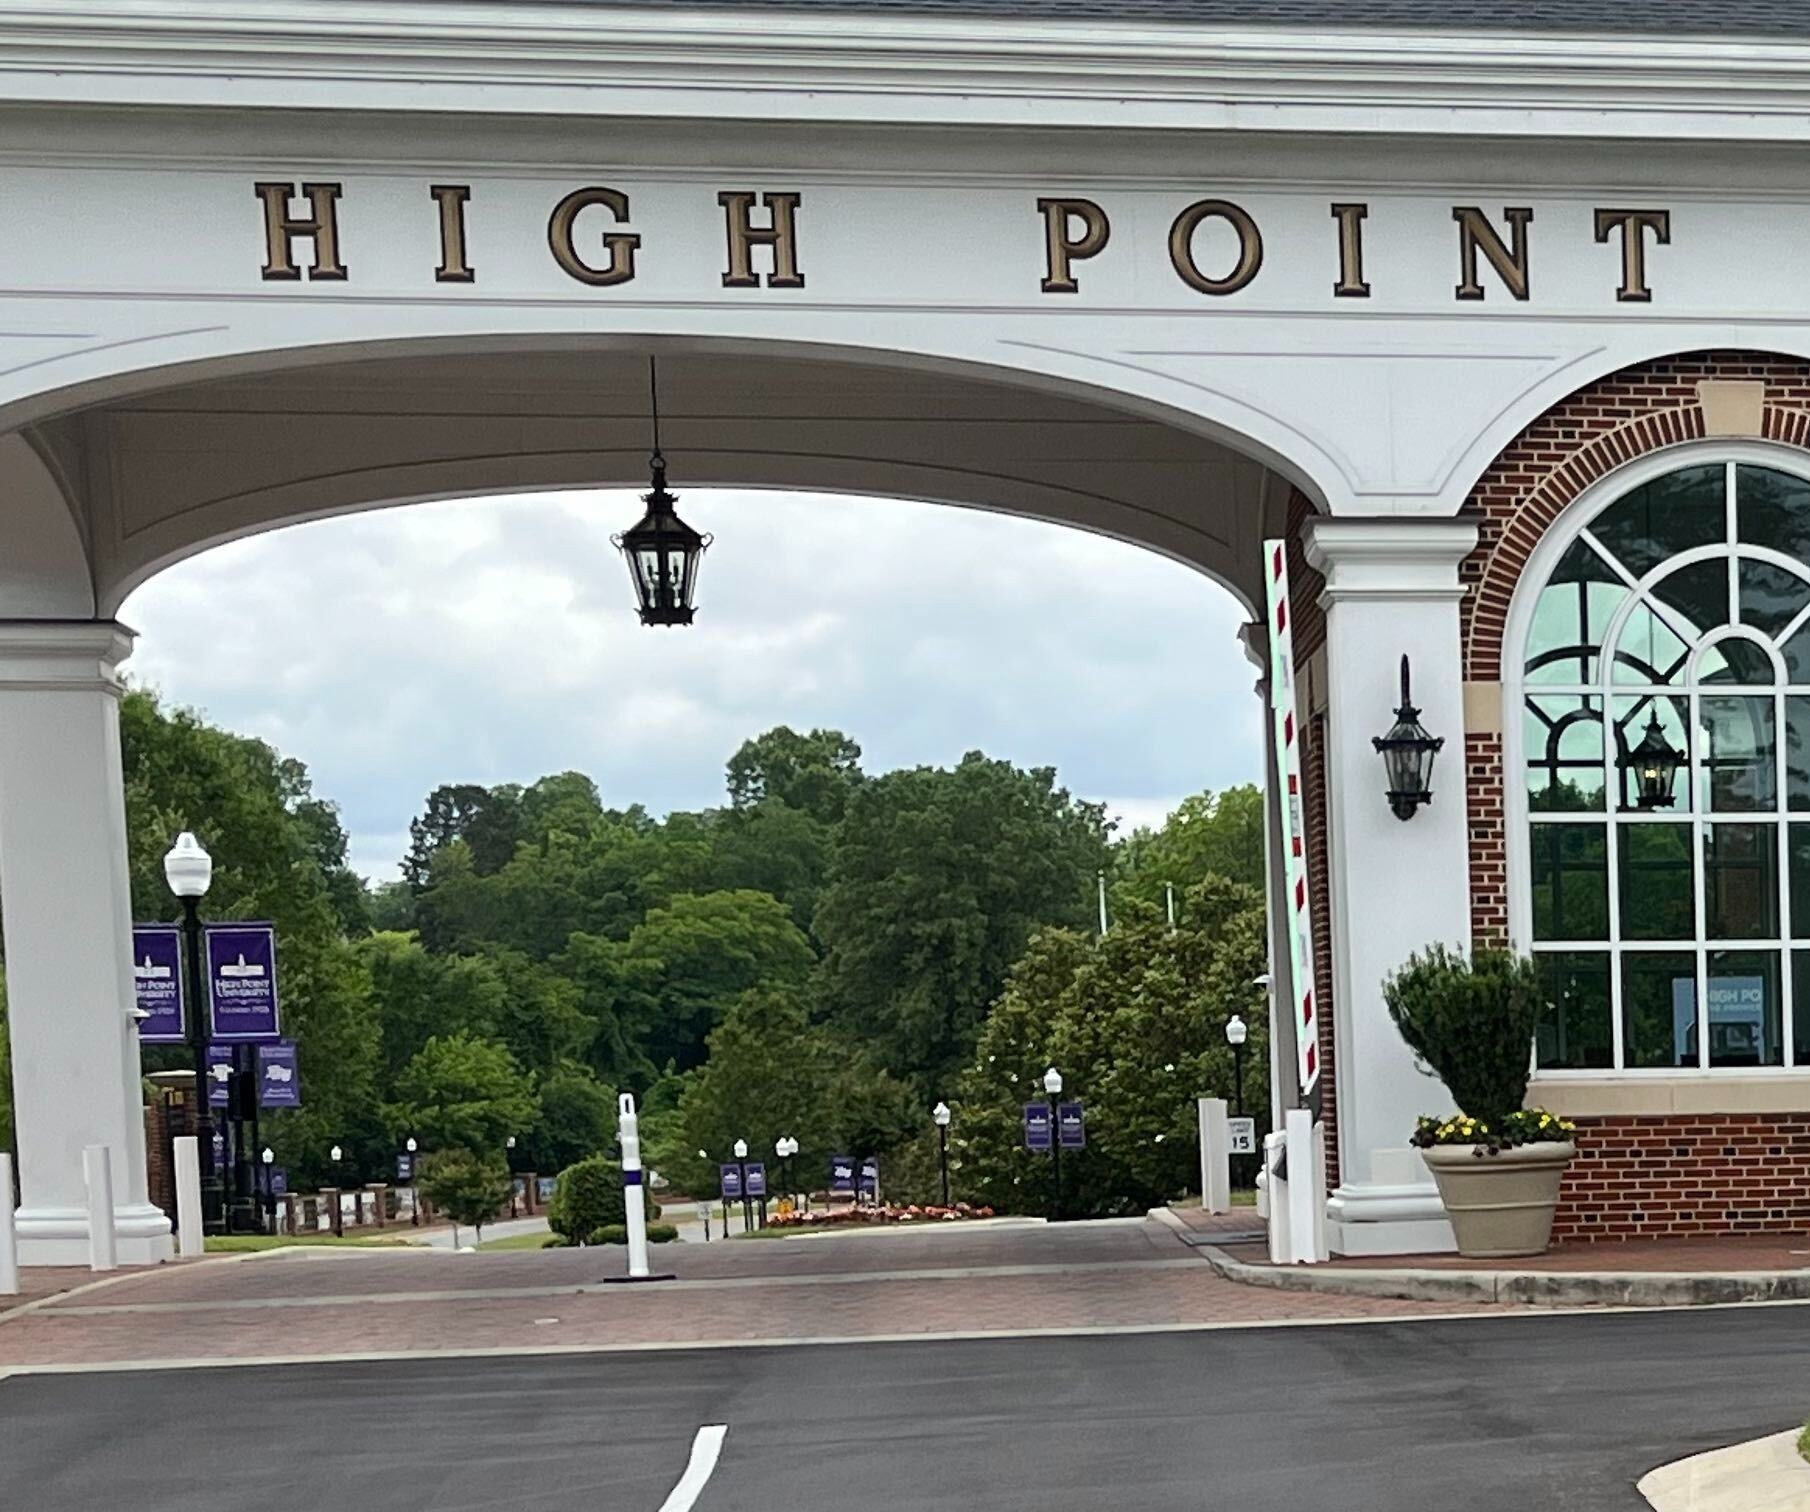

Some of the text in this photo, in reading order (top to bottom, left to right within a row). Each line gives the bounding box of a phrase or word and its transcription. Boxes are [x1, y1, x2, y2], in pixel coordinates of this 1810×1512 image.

[254, 181, 805, 288] HIGH
[1037, 197, 1671, 303] POINT
[241, 979, 270, 989] POINT
[1232, 1136, 1250, 1150] 15
